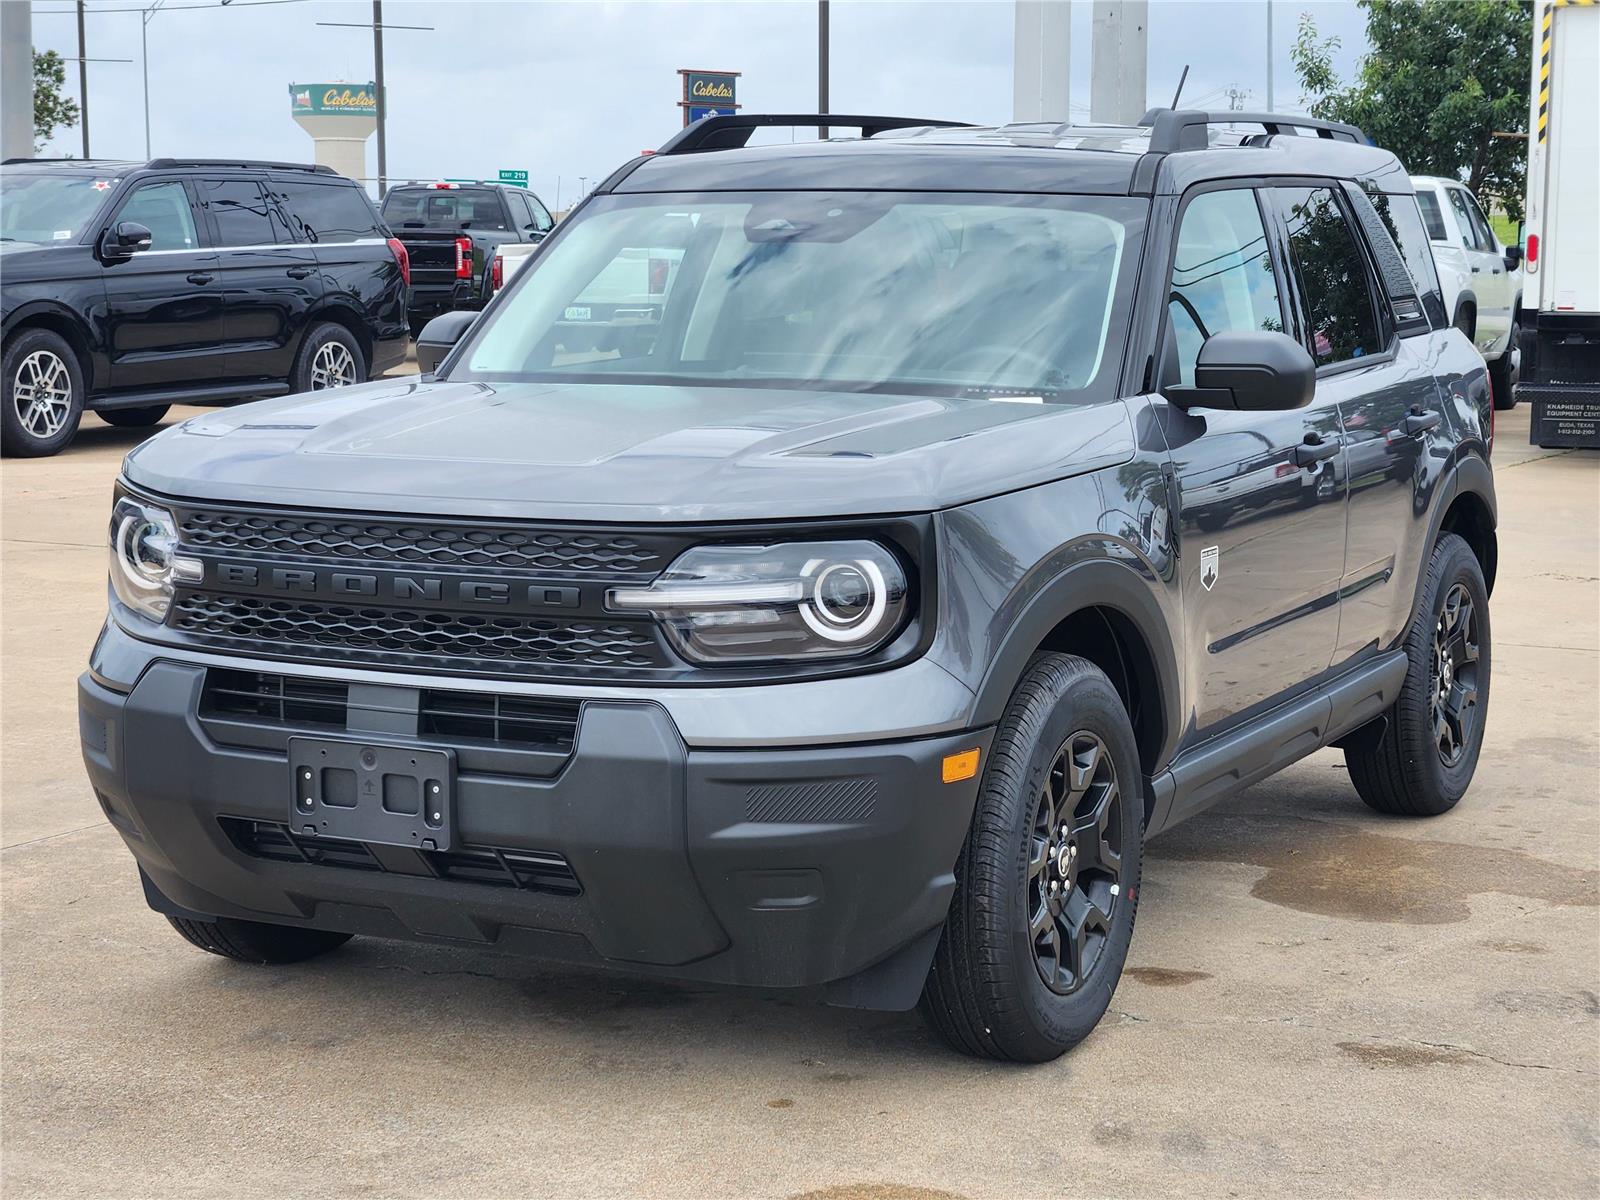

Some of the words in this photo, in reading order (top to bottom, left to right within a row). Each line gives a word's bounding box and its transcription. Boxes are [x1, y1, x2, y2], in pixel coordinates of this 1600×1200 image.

[692, 80, 732, 97] Cabela's
[514, 171, 526, 179] 219
[217, 563, 582, 608] BRONCO
